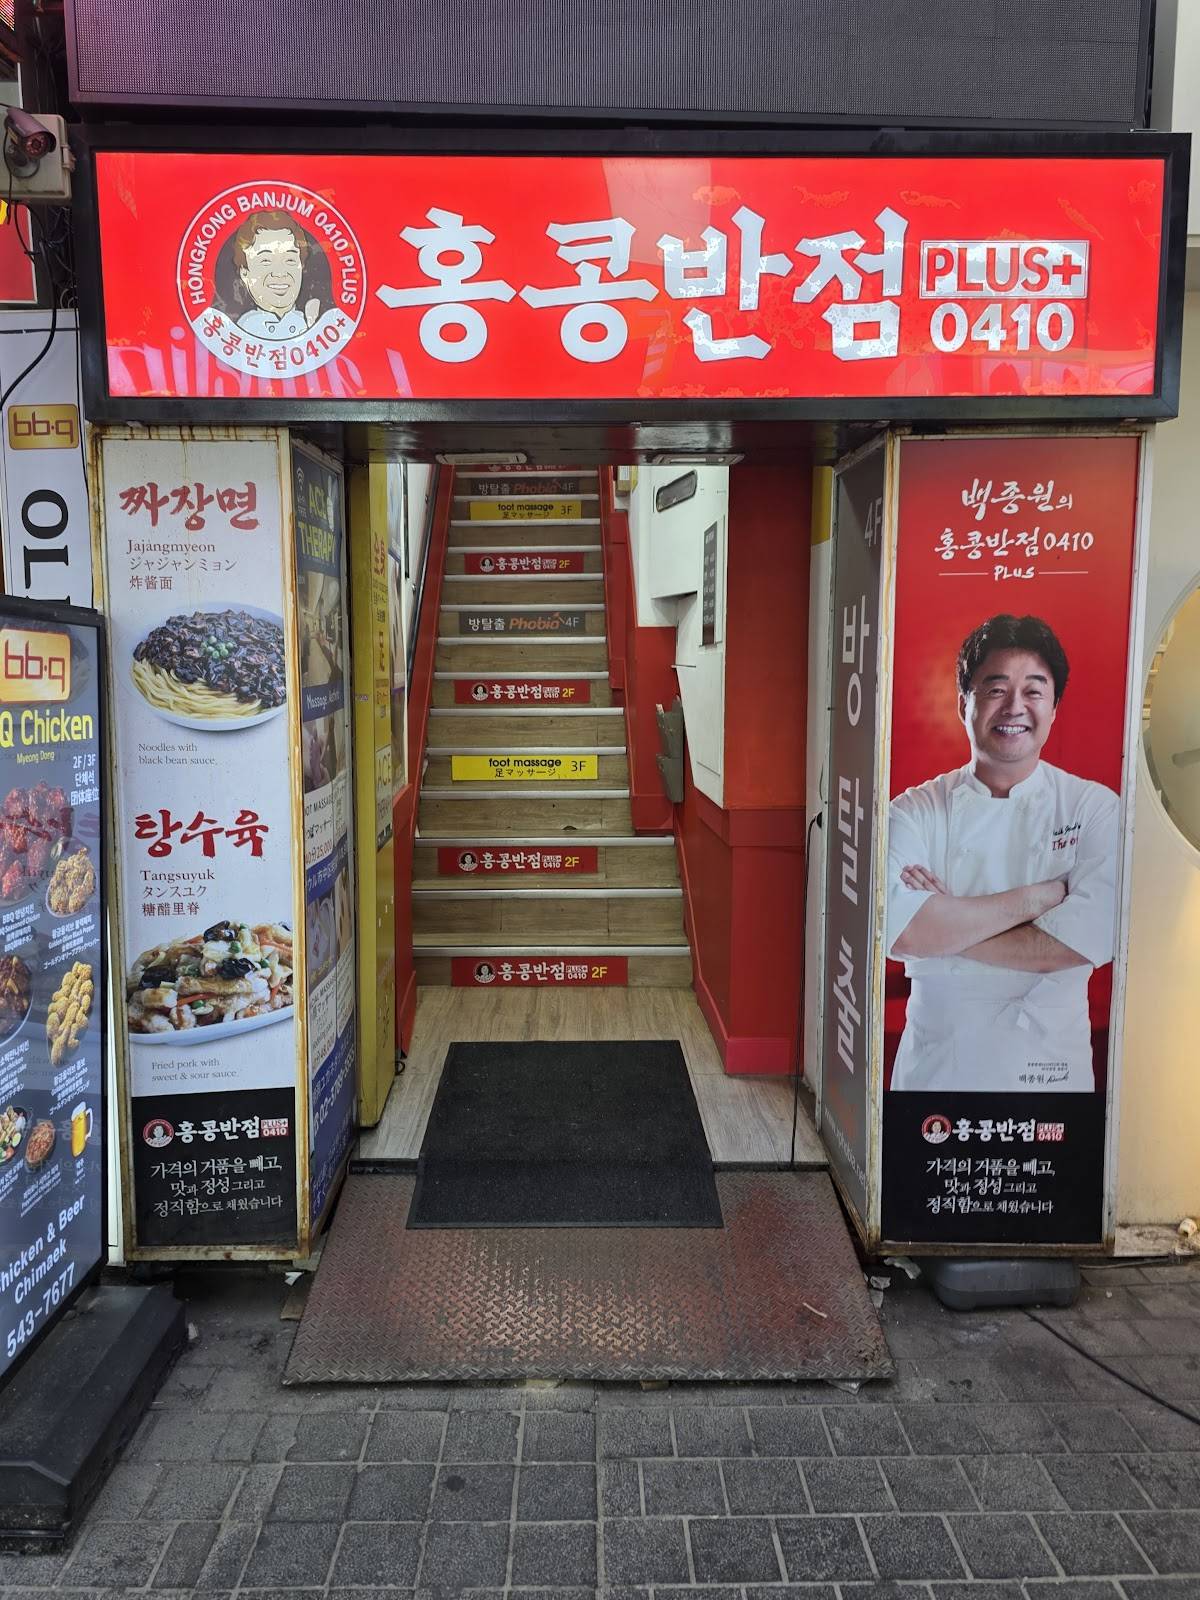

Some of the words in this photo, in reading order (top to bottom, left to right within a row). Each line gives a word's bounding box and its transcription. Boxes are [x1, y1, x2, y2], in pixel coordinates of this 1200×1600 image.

[191, 204, 237, 306] HONGKONG
[236, 190, 315, 219] BANJUM
[314, 210, 348, 254] 0410
[338, 253, 357, 306] PLUS
[375, 205, 909, 363] 홍콩반점
[929, 301, 1075, 354] 0410
[562, 482, 575, 491] 4F
[119, 481, 260, 532] 짜장면
[961, 477, 1073, 521] 백종원의
[498, 503, 515, 512] foot
[516, 503, 554, 513] massage
[560, 505, 573, 516] 3F
[126, 539, 216, 555] Jajangmyeon
[495, 557, 543, 572] 홍콩반점
[559, 560, 571, 569] 2F
[468, 617, 506, 632] 방탈출
[509, 615, 561, 631] Phobia
[564, 617, 580, 628] 4F
[490, 684, 543, 700] 홍콩반점
[562, 687, 576, 699] 2F
[20, 708, 94, 747] Chicken
[16, 752, 40, 765] Myeong
[40, 749, 55, 762] Dong
[138, 743, 176, 753] Noodles
[177, 743, 198, 753] with
[138, 754, 164, 766] black
[165, 754, 188, 766] bean
[489, 757, 511, 768] foot
[513, 758, 562, 769] massage
[571, 760, 587, 773] 3F
[494, 768, 557, 779] 足マッサージ
[134, 809, 269, 858] 탕수육
[480, 852, 541, 870] 홍콩반점
[564, 856, 580, 868] 2F
[140, 869, 215, 883] Tangsuyuk
[142, 885, 207, 899] タンスユク
[497, 961, 565, 981] 홍콩반점
[591, 966, 608, 979] 2F
[151, 1060, 175, 1071] Fried
[176, 1060, 198, 1073] pork
[199, 1058, 220, 1069] with
[151, 1073, 178, 1082] sweet
[179, 1072, 188, 1081] &
[189, 1072, 210, 1081] sour
[175, 1115, 261, 1144] 홍콩반점
[262, 1128, 287, 1137] 0410
[951, 1118, 1037, 1143] 홍콩반점
[1037, 1132, 1063, 1142] 0410
[150, 1160, 197, 1179] 가격의
[200, 1156, 247, 1175] 거품을
[249, 1155, 283, 1172] 빼고,
[925, 1157, 972, 1177] 가격의
[974, 1157, 1021, 1177] 거품을
[1022, 1158, 1056, 1177] 빼고,
[170, 1179, 199, 1198] 맛과
[201, 1177, 230, 1195] 정성
[231, 1179, 266, 1191] 그리고
[944, 1177, 971, 1195] 맛과
[973, 1177, 1002, 1195] 정성
[1003, 1181, 1038, 1194] 그리고
[153, 1198, 224, 1218] 정직함으로
[225, 1195, 283, 1212] 채웠습니다
[926, 1195, 995, 1214] 정직함으로
[995, 1199, 1054, 1214] 채웠습니다
[0, 1236, 43, 1293] hicken
[46, 1222, 56, 1243] &
[58, 1195, 86, 1232] Beer
[14, 1237, 67, 1305] Chimaek
[7, 1261, 75, 1359] 543-7677
